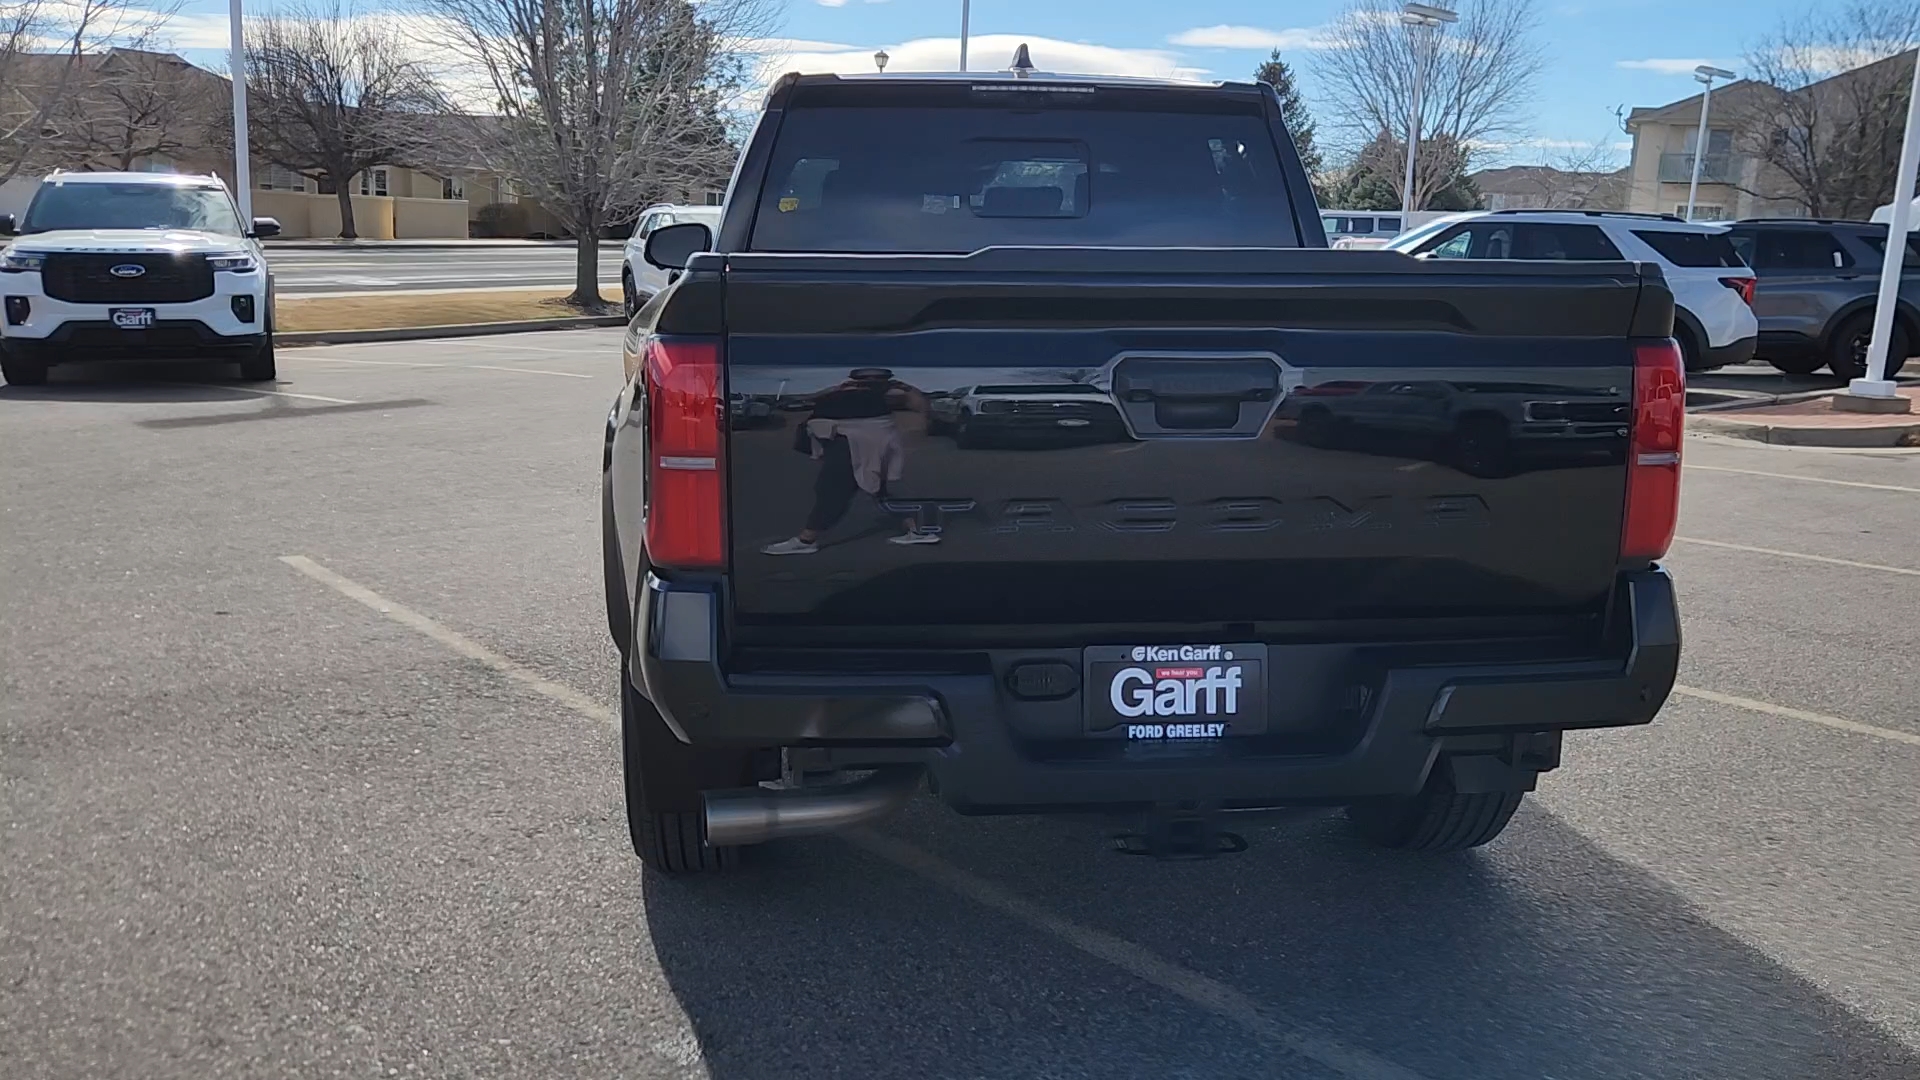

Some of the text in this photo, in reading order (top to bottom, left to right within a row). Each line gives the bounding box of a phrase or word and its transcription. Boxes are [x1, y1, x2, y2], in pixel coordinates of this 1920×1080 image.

[113, 311, 152, 326] Garff
[878, 493, 1491, 534] TACOMA
[1146, 645, 1222, 661] Ken Garff
[1110, 666, 1242, 717] Garff
[1128, 723, 1224, 739] FORD GREELEY
